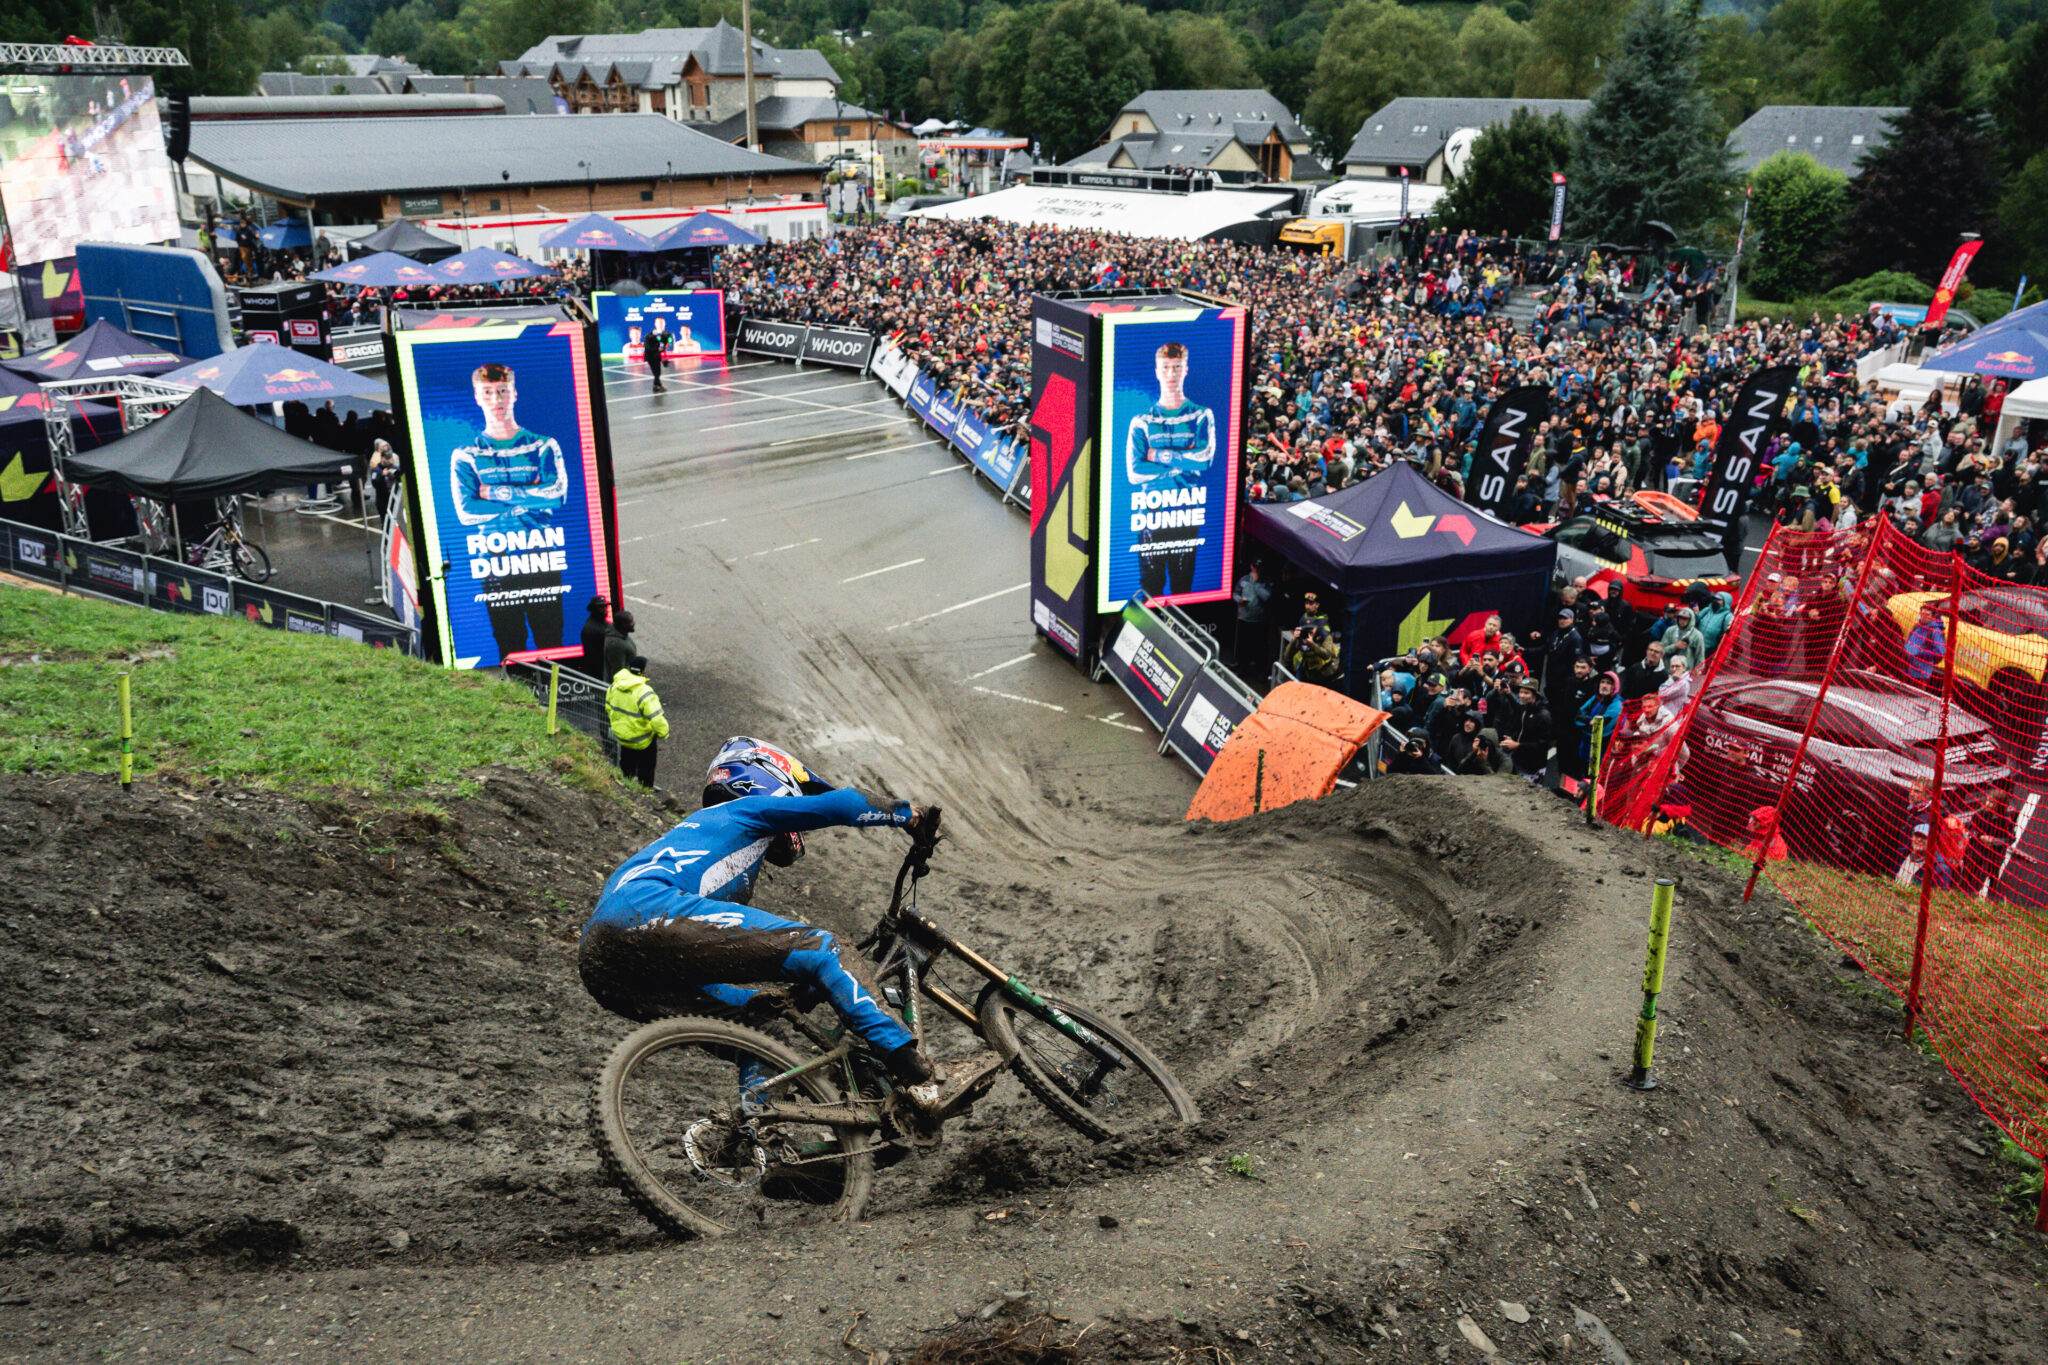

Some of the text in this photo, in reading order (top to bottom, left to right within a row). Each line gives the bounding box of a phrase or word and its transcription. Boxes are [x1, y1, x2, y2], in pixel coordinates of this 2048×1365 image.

[244, 298, 276, 306] WHOOP
[745, 328, 795, 348] WHOOP
[811, 336, 862, 357] WHOOP
[1974, 360, 2036, 374] Red Bull
[264, 380, 334, 395] Red Bull
[1131, 486, 1207, 511] RONAN
[1131, 508, 1206, 532] DUNNE
[466, 526, 565, 555] RONAN
[1129, 538, 1206, 552] MONDRAKER
[470, 550, 568, 579] DUNNE
[474, 585, 572, 603] MONDRAKER
[1134, 655, 1154, 677] WORLD
[1137, 647, 1164, 676] MOUNTAIN
